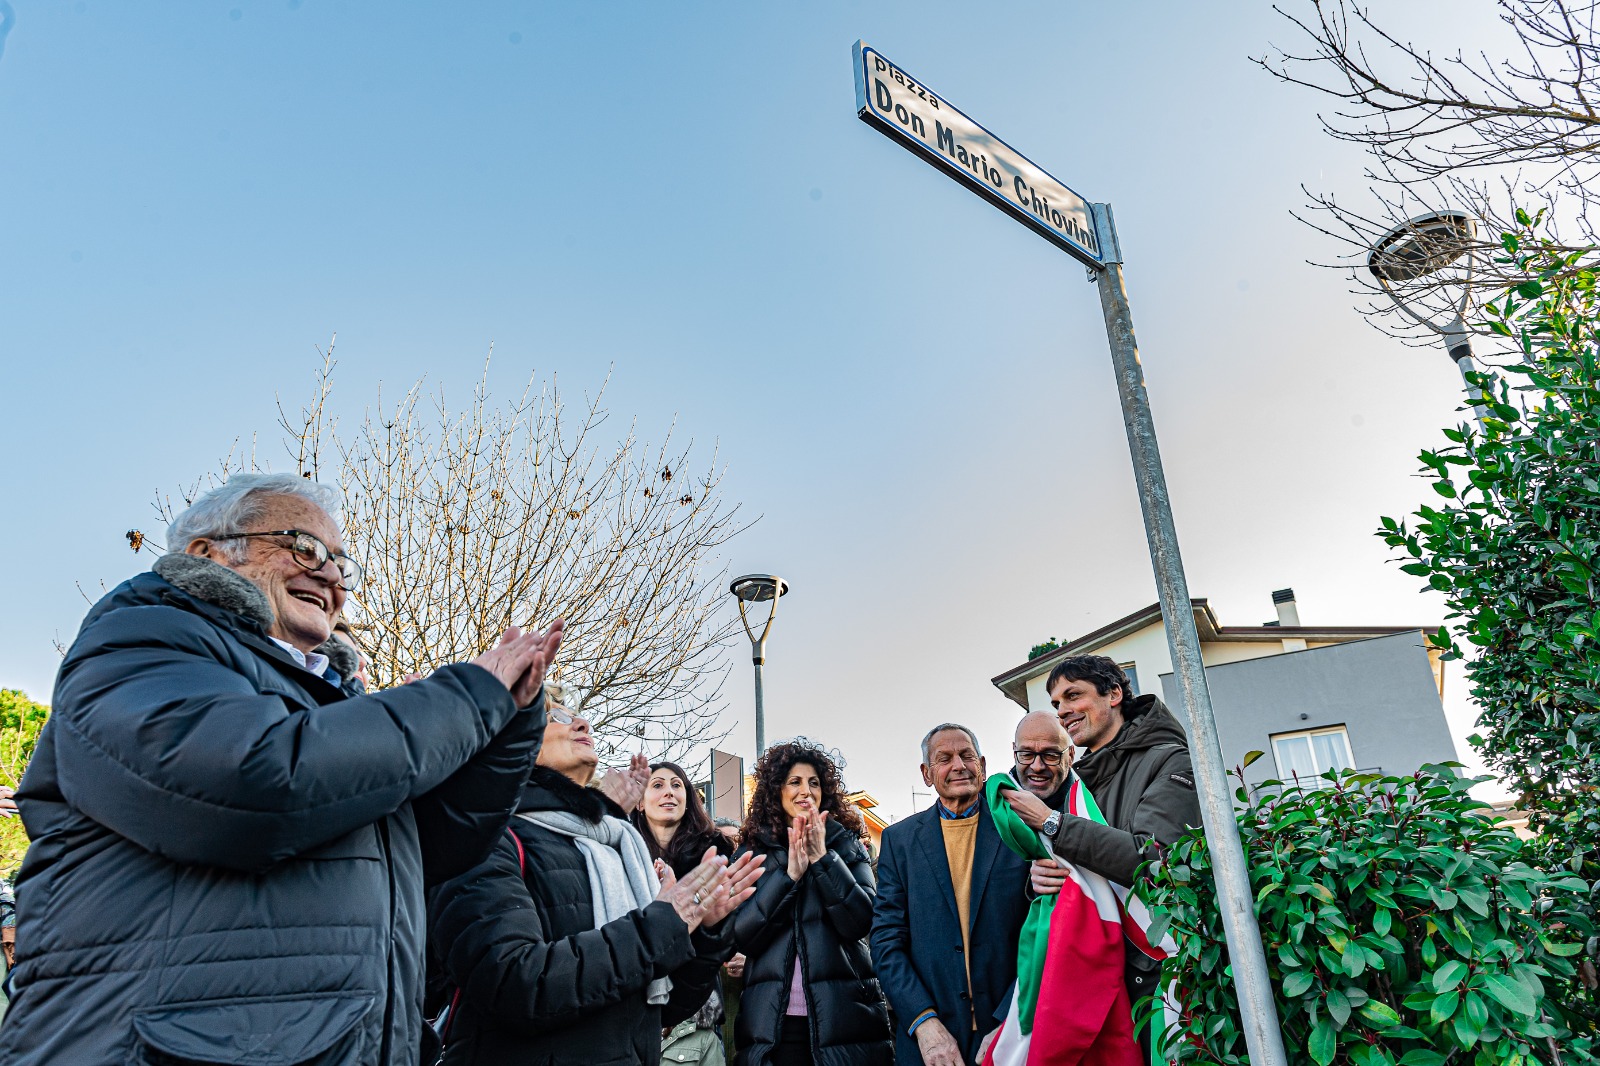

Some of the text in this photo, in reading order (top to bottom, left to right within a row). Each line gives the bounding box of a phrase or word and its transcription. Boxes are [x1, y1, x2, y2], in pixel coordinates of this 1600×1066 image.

[874, 55, 940, 110] piazza
[874, 77, 1098, 254] Don Mario Chiovini
